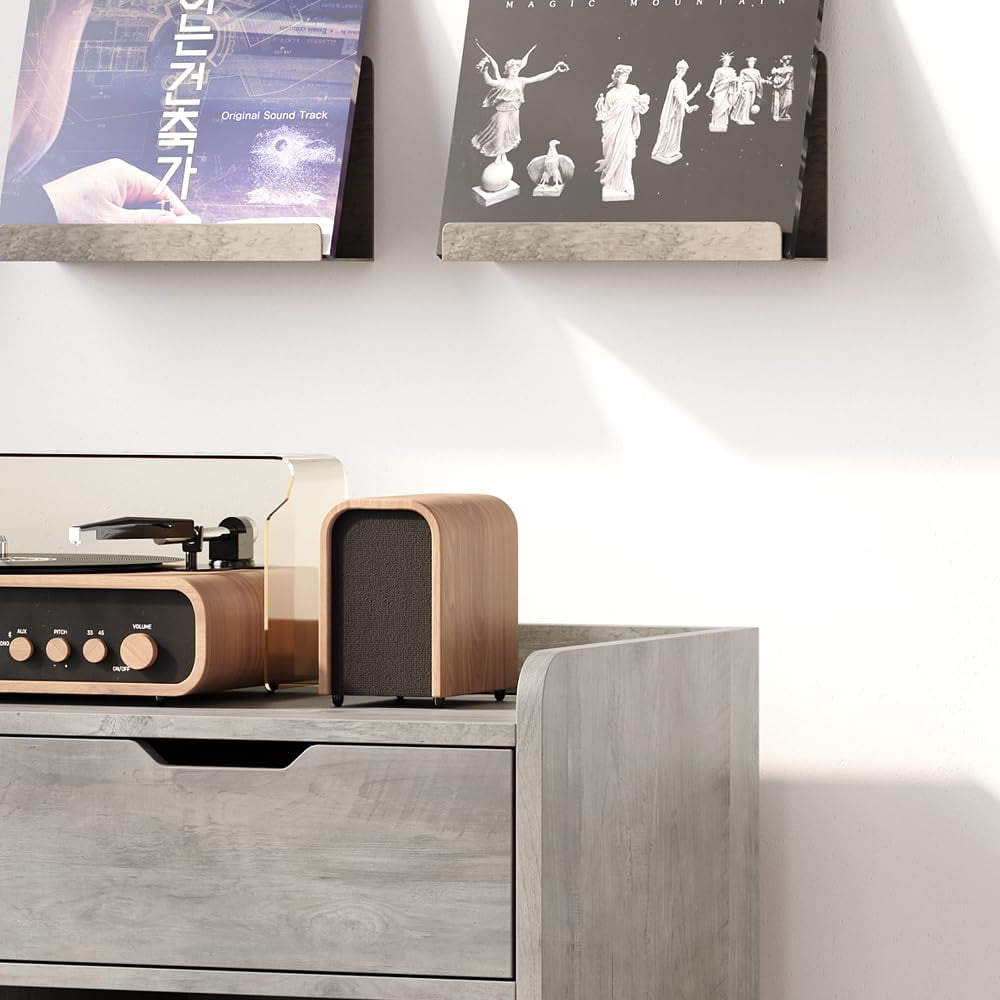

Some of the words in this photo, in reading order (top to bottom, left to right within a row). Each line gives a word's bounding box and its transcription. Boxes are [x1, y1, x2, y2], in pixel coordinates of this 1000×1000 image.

[505, 0, 596, 9] MAGIC
[221, 111, 260, 122] Original
[263, 110, 296, 120] Sound
[299, 110, 328, 120] Track
